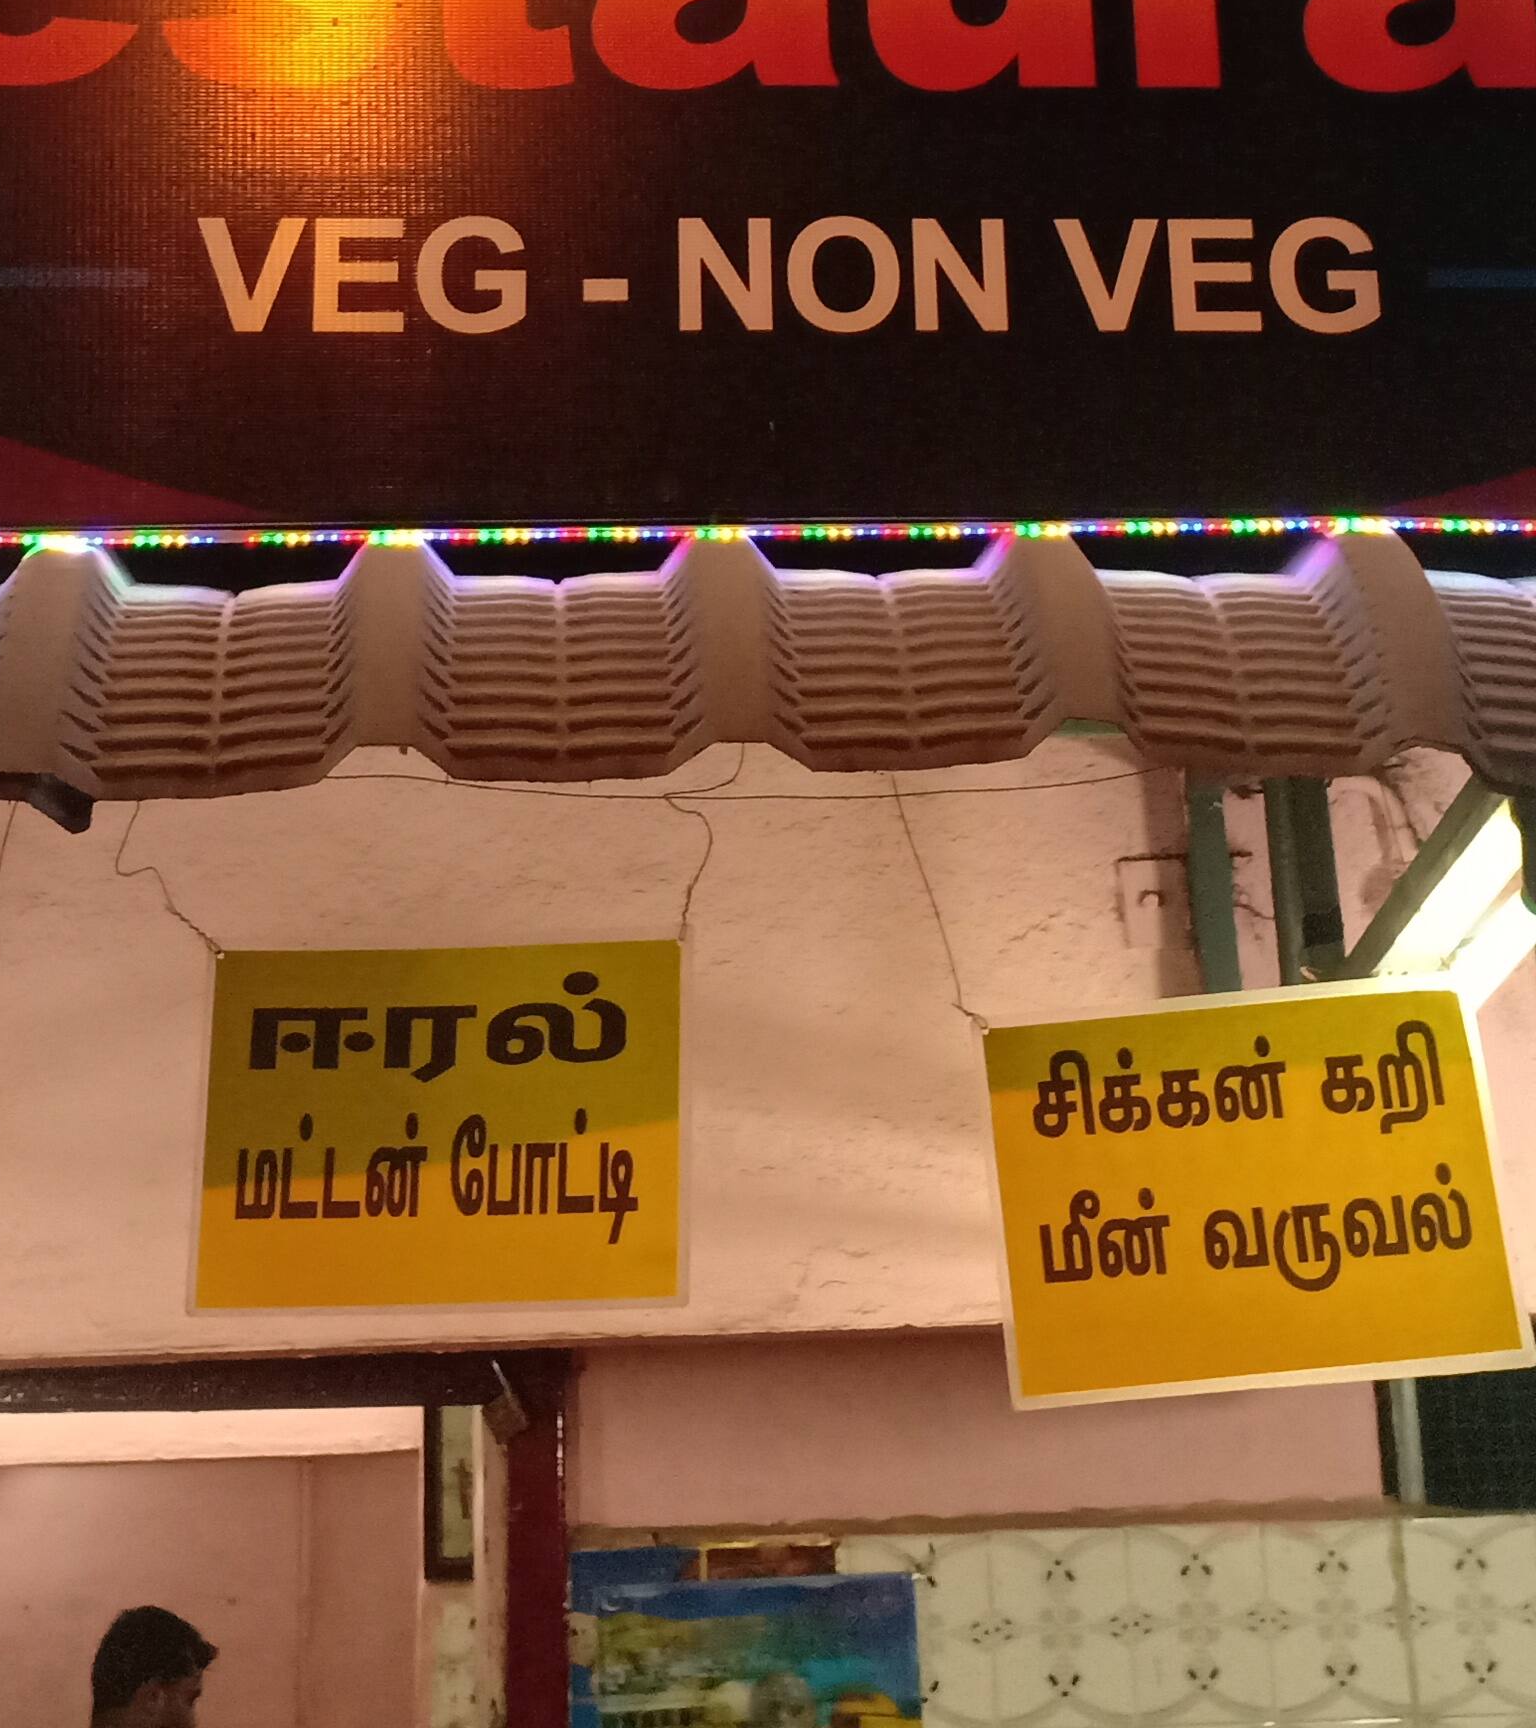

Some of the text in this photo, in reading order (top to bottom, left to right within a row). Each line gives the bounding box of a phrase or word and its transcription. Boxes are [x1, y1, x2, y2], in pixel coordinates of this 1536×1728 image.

[195, 215, 1383, 337] VEG - NON VEG
[248, 971, 627, 1083] ஈரல்
[1033, 1019, 1446, 1138] சிக்கன் கறி
[234, 1107, 639, 1245] மட்டன் போட்டி
[1040, 1163, 1472, 1292] மீன் வருவல்
